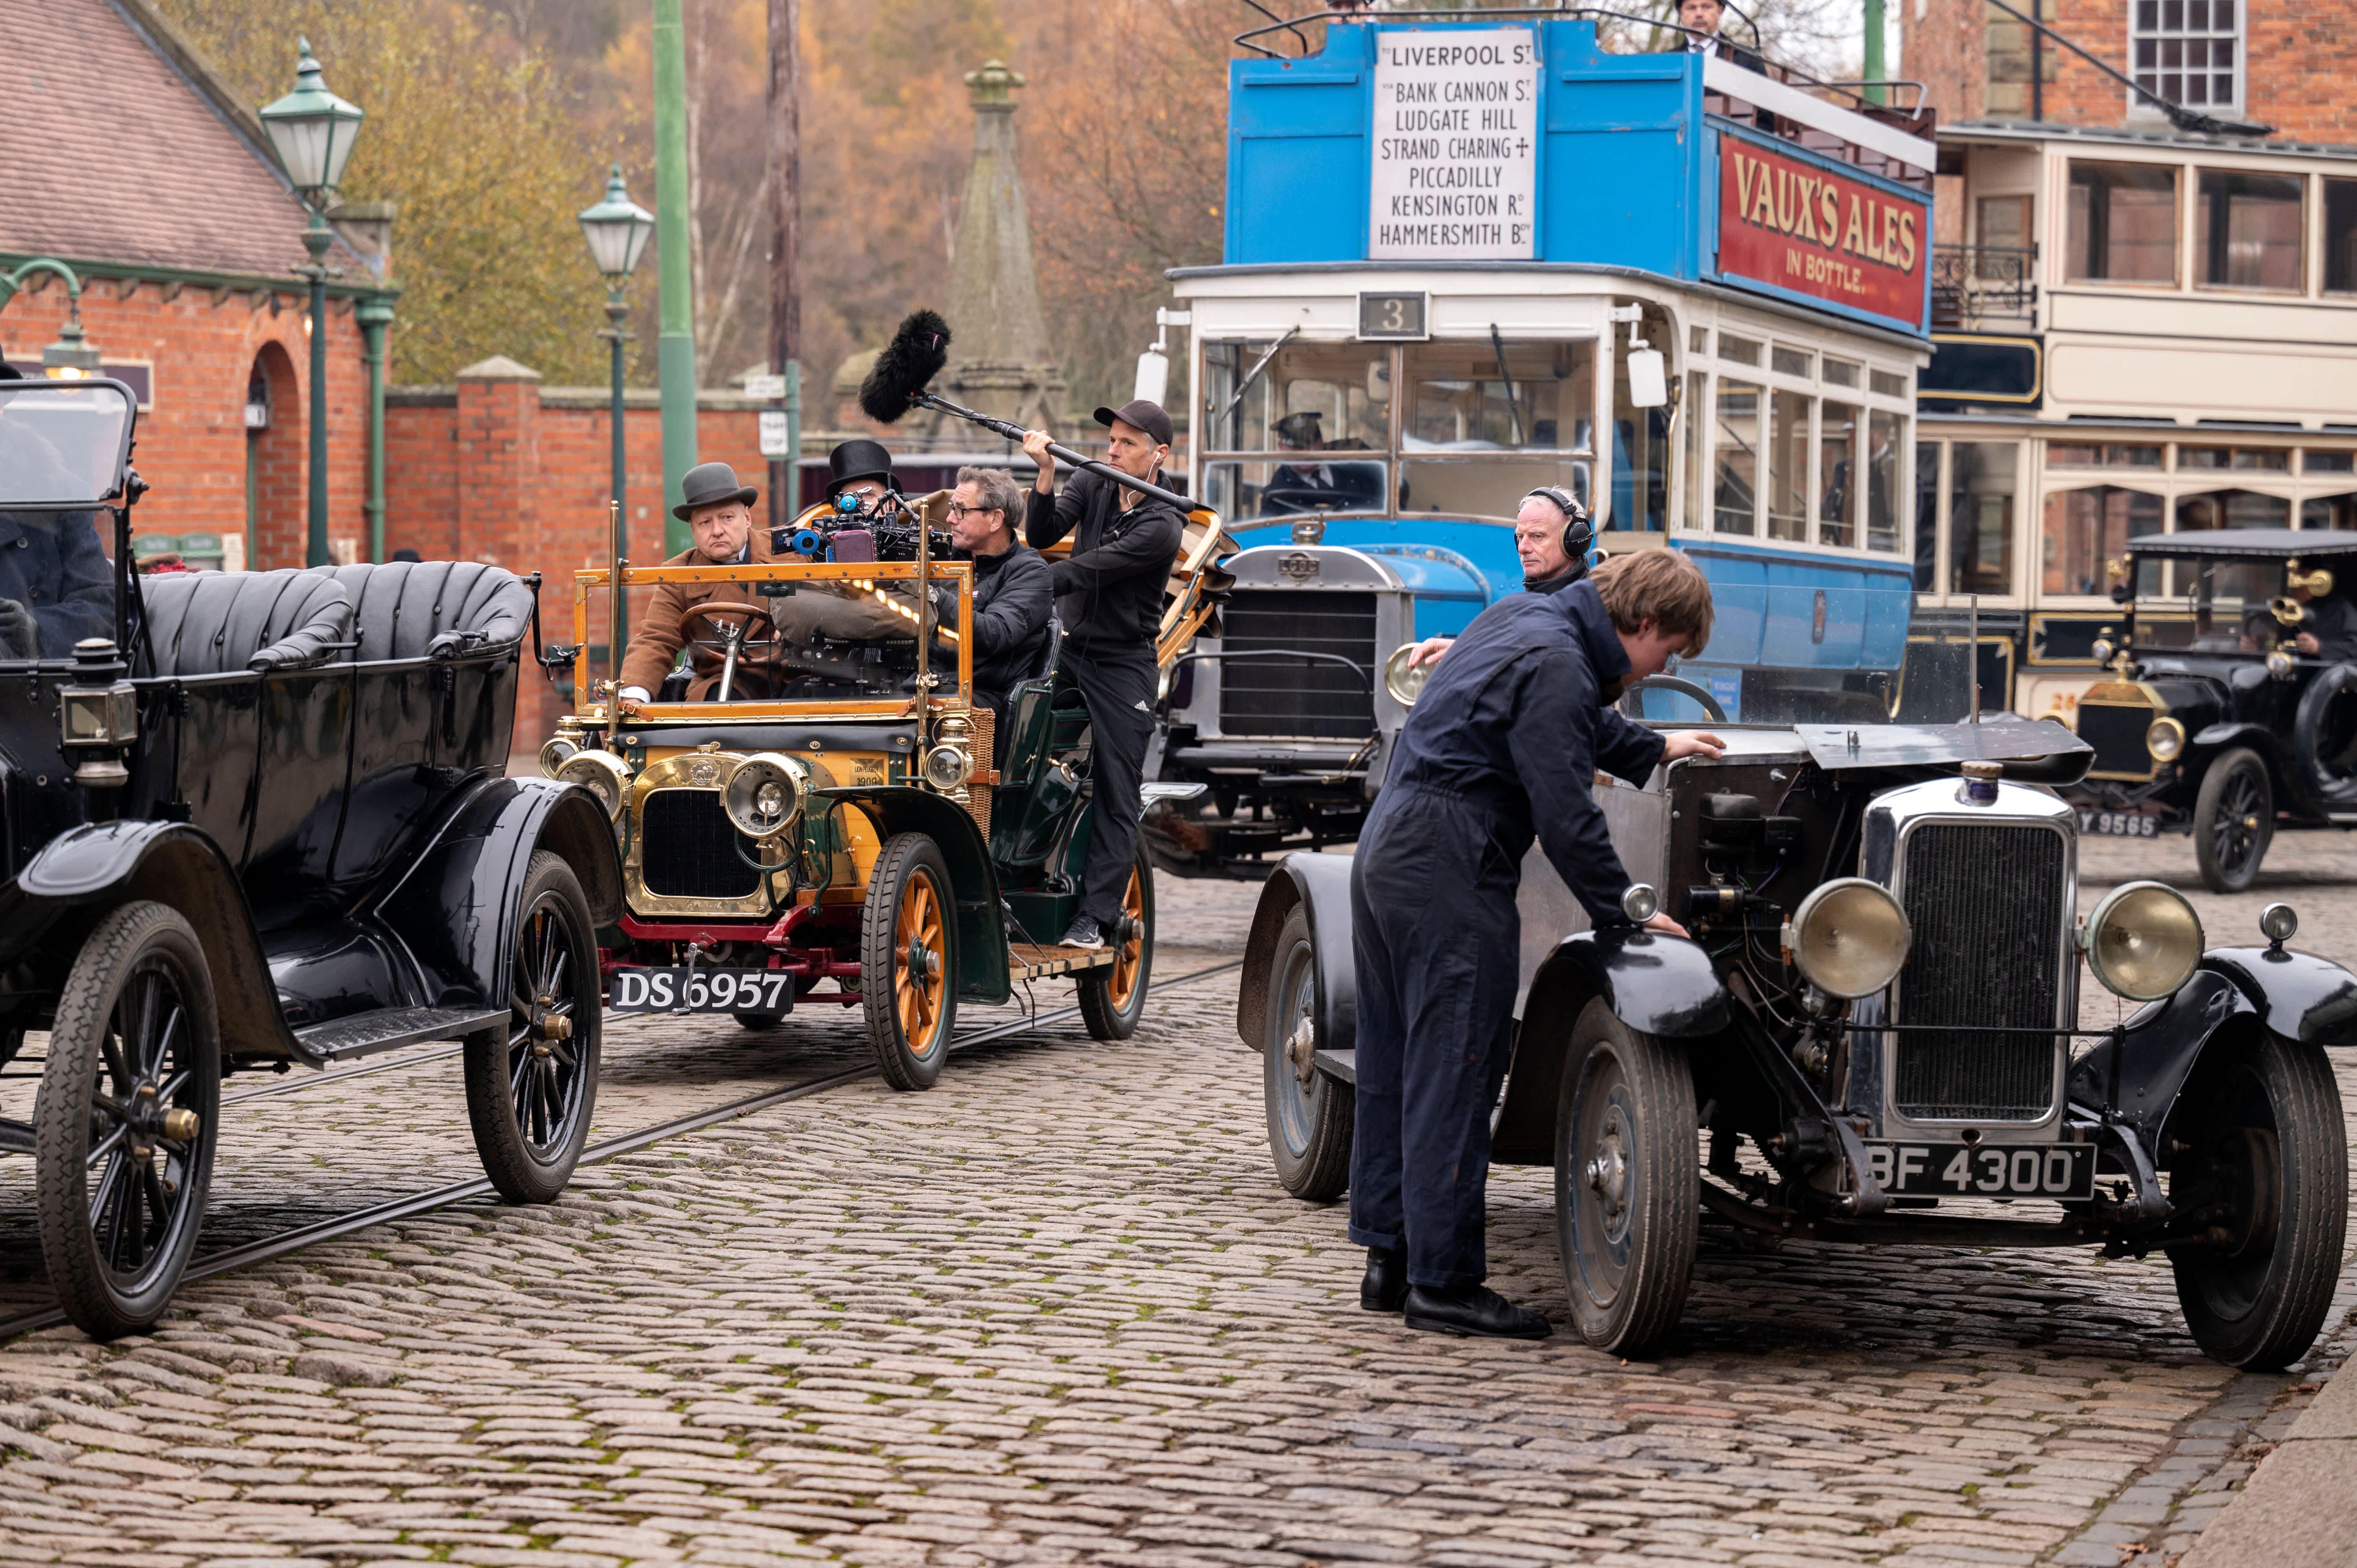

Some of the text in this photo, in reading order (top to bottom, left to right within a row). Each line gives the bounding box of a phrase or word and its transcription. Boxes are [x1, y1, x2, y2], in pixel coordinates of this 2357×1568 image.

[1392, 45, 1505, 66] LIVERPOOL
[1396, 82, 1437, 103] BANK
[1444, 81, 1508, 103] CANNON
[1396, 108, 1517, 132] LUDGATE HILL
[1381, 137, 1511, 160] STRAND CHARING
[1410, 166, 1502, 189] PICCADILLY
[1392, 195, 1498, 217] KENSINGTON
[1734, 152, 1916, 273] VAUX'S ALES
[1380, 224, 1501, 246] HAMMERSMITH
[1786, 247, 1802, 278] IN
[1382, 298, 1403, 330] 3
[2098, 812, 2155, 836] 9565
[616, 972, 787, 1008] DS 6957
[1865, 1145, 2073, 1193] BF 4300
